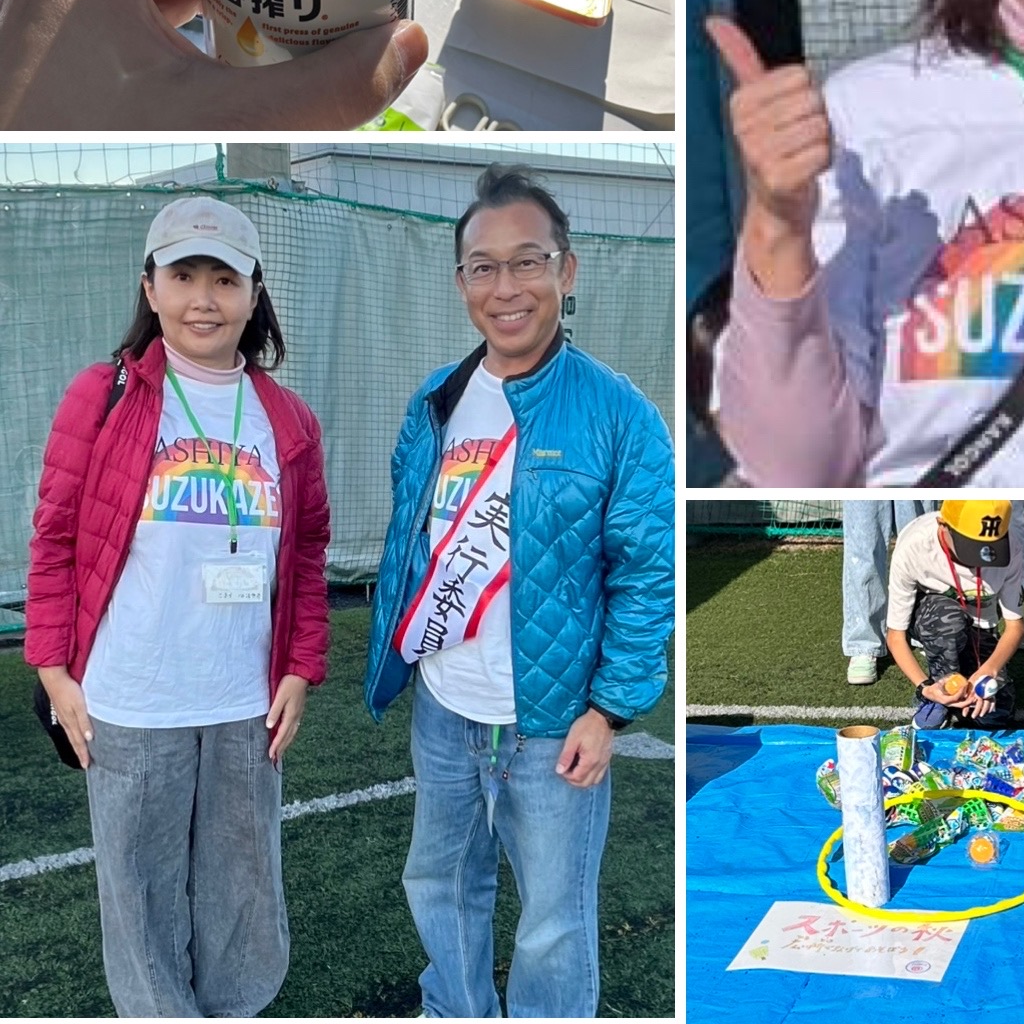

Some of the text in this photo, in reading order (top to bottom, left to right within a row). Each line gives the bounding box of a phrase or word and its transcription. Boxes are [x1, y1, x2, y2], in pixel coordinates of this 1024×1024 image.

[262, 21, 360, 36] first press of genuine
[268, 35, 310, 46] delicious
[155, 435, 262, 467] ASHIYA
[144, 475, 279, 517] UZUKAZE
[412, 492, 510, 657] 実行委員
[782, 914, 954, 943] スポーツの秋
